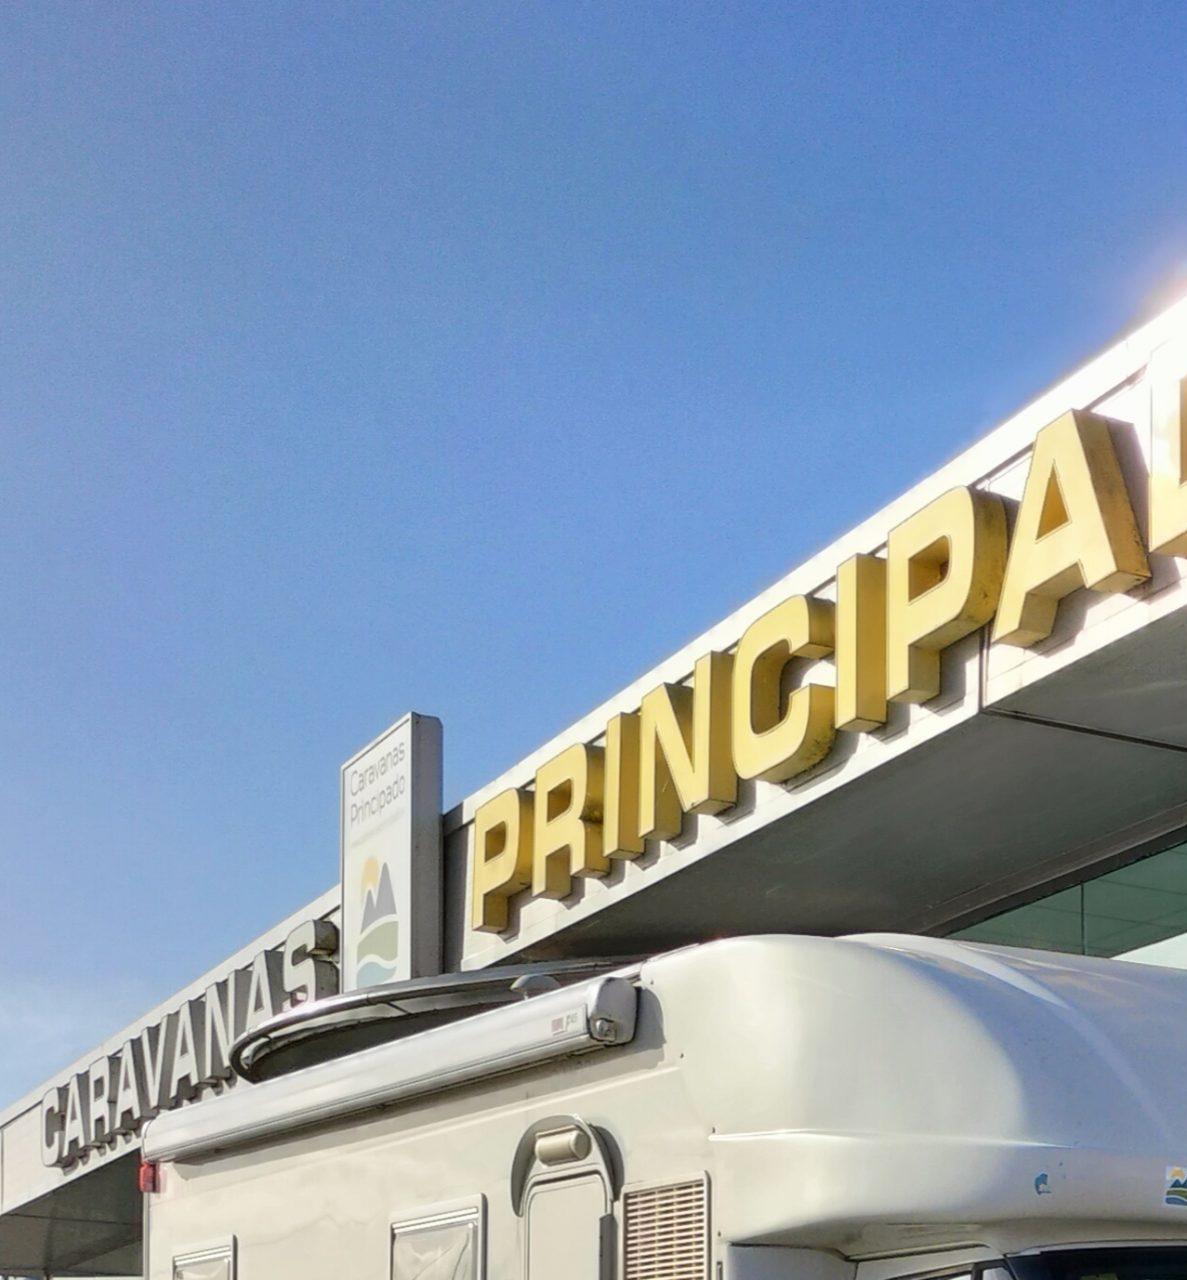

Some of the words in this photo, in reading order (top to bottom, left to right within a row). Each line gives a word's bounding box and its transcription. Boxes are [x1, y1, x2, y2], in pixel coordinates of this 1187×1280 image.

[350, 741, 406, 797] Caravanas
[350, 773, 406, 829] Principado
[40, 918, 341, 1168] CARAVANAS
